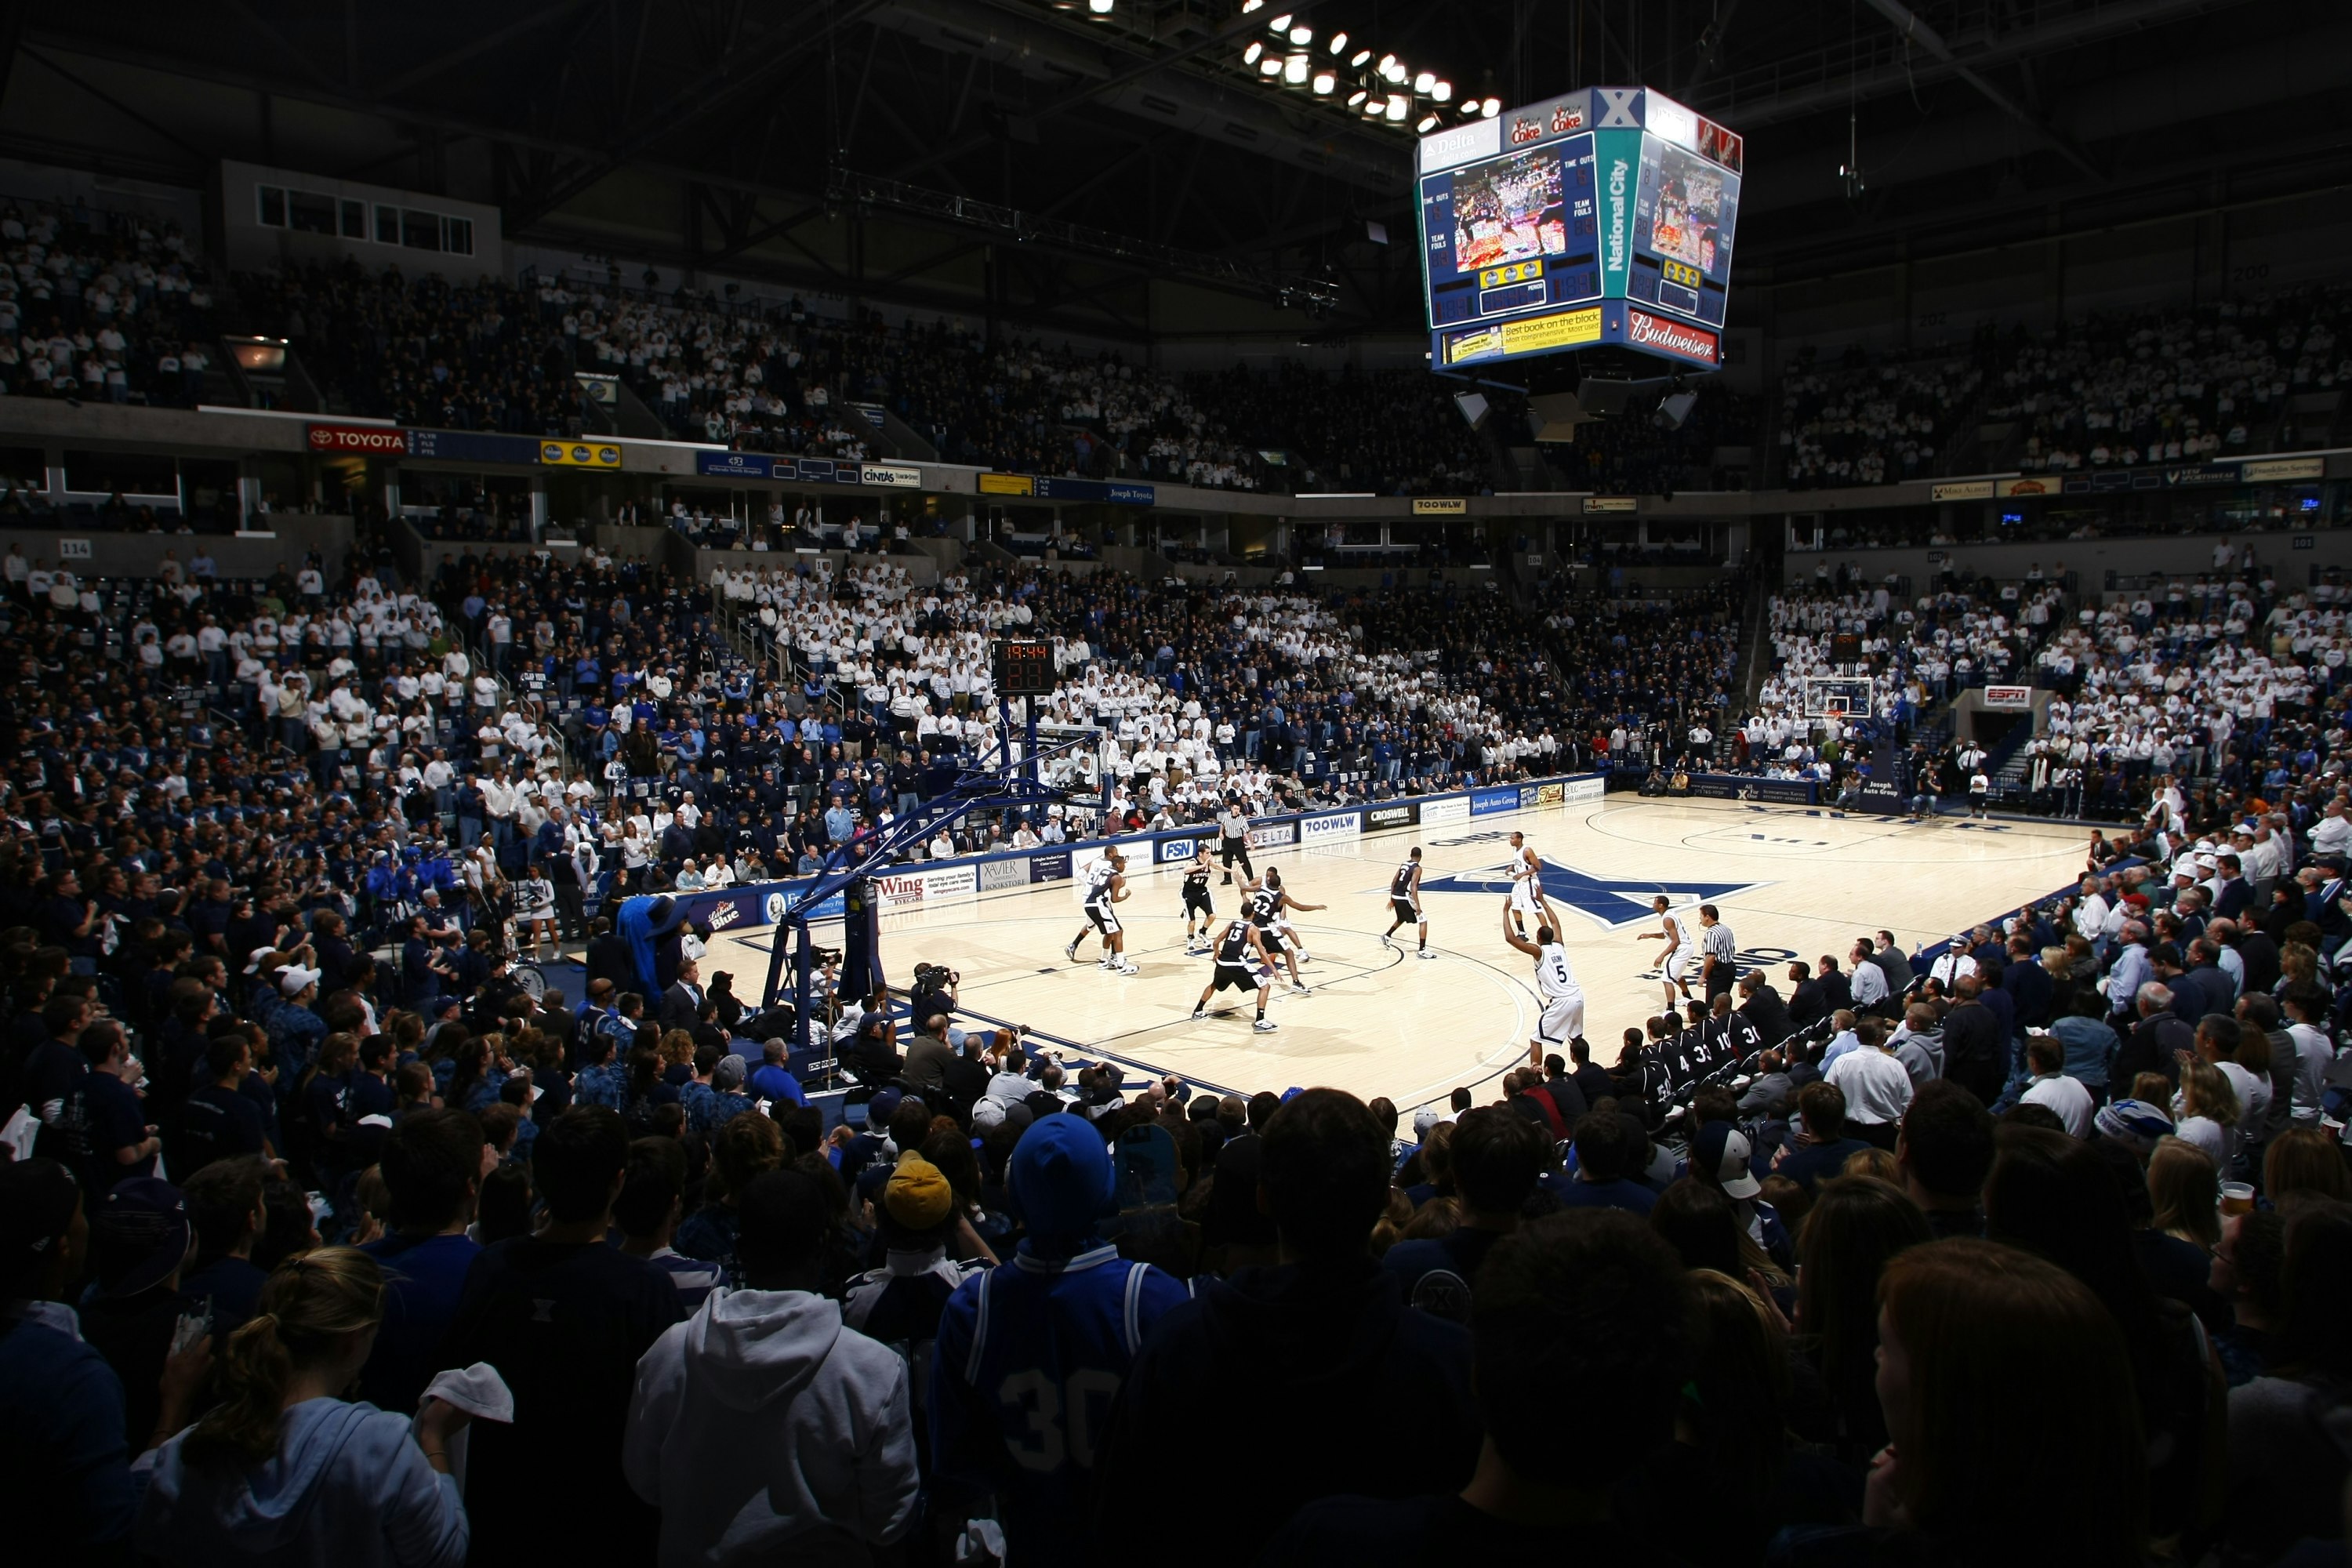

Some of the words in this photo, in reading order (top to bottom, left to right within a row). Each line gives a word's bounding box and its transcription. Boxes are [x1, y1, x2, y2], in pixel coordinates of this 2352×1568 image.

[1551, 116, 1581, 133] Coke
[1512, 128, 1541, 144] Coke
[1437, 134, 1475, 154] Delta
[1565, 160, 1577, 169] TIME
[1580, 155, 1595, 165] OUTS
[1423, 196, 1435, 205] TIME
[1436, 193, 1449, 202] OUTS
[1574, 199, 1590, 208] TEAM
[1573, 207, 1592, 217] FOULS
[1431, 241, 1446, 250] FOULS
[1528, 283, 1544, 292] PERIOD
[1506, 325, 1522, 336] Best
[1524, 321, 1544, 332] book
[1547, 320, 1558, 328] on
[1560, 317, 1574, 327] the
[1632, 312, 1713, 357] Budweiser
[336, 432, 404, 448] TOYOTA
[1110, 489, 1131, 499] Joseph
[1132, 491, 1153, 500] Toyota
[62, 543, 88, 554] 114
[2295, 539, 2311, 547] 101
[1008, 646, 1046, 659] 19:44
[1987, 689, 2026, 699] ESPN
[1870, 781, 1891, 789] Joseph
[1880, 789, 1897, 797] Group
[1472, 800, 1488, 811] Joseph
[1490, 798, 1501, 808] Auto
[1502, 797, 1518, 806] Group
[1371, 808, 1410, 821] CROSWELL
[1305, 816, 1356, 833] 700WLW
[1253, 829, 1291, 844] DELTA
[1130, 853, 1150, 862] wireless
[1167, 845, 1190, 858] FSN
[984, 860, 1018, 878] XAVIER
[880, 877, 924, 895] Wing
[985, 879, 1025, 891] BOOKSTORE
[895, 896, 924, 905] EYECARE
[1254, 898, 1271, 916] 22
[708, 901, 735, 922] Labatt
[710, 909, 739, 931] Blue
[1228, 928, 1243, 942] 15
[1556, 965, 1567, 983] 5
[1716, 1032, 1731, 1051] 10
[1679, 1055, 1690, 1072] 4
